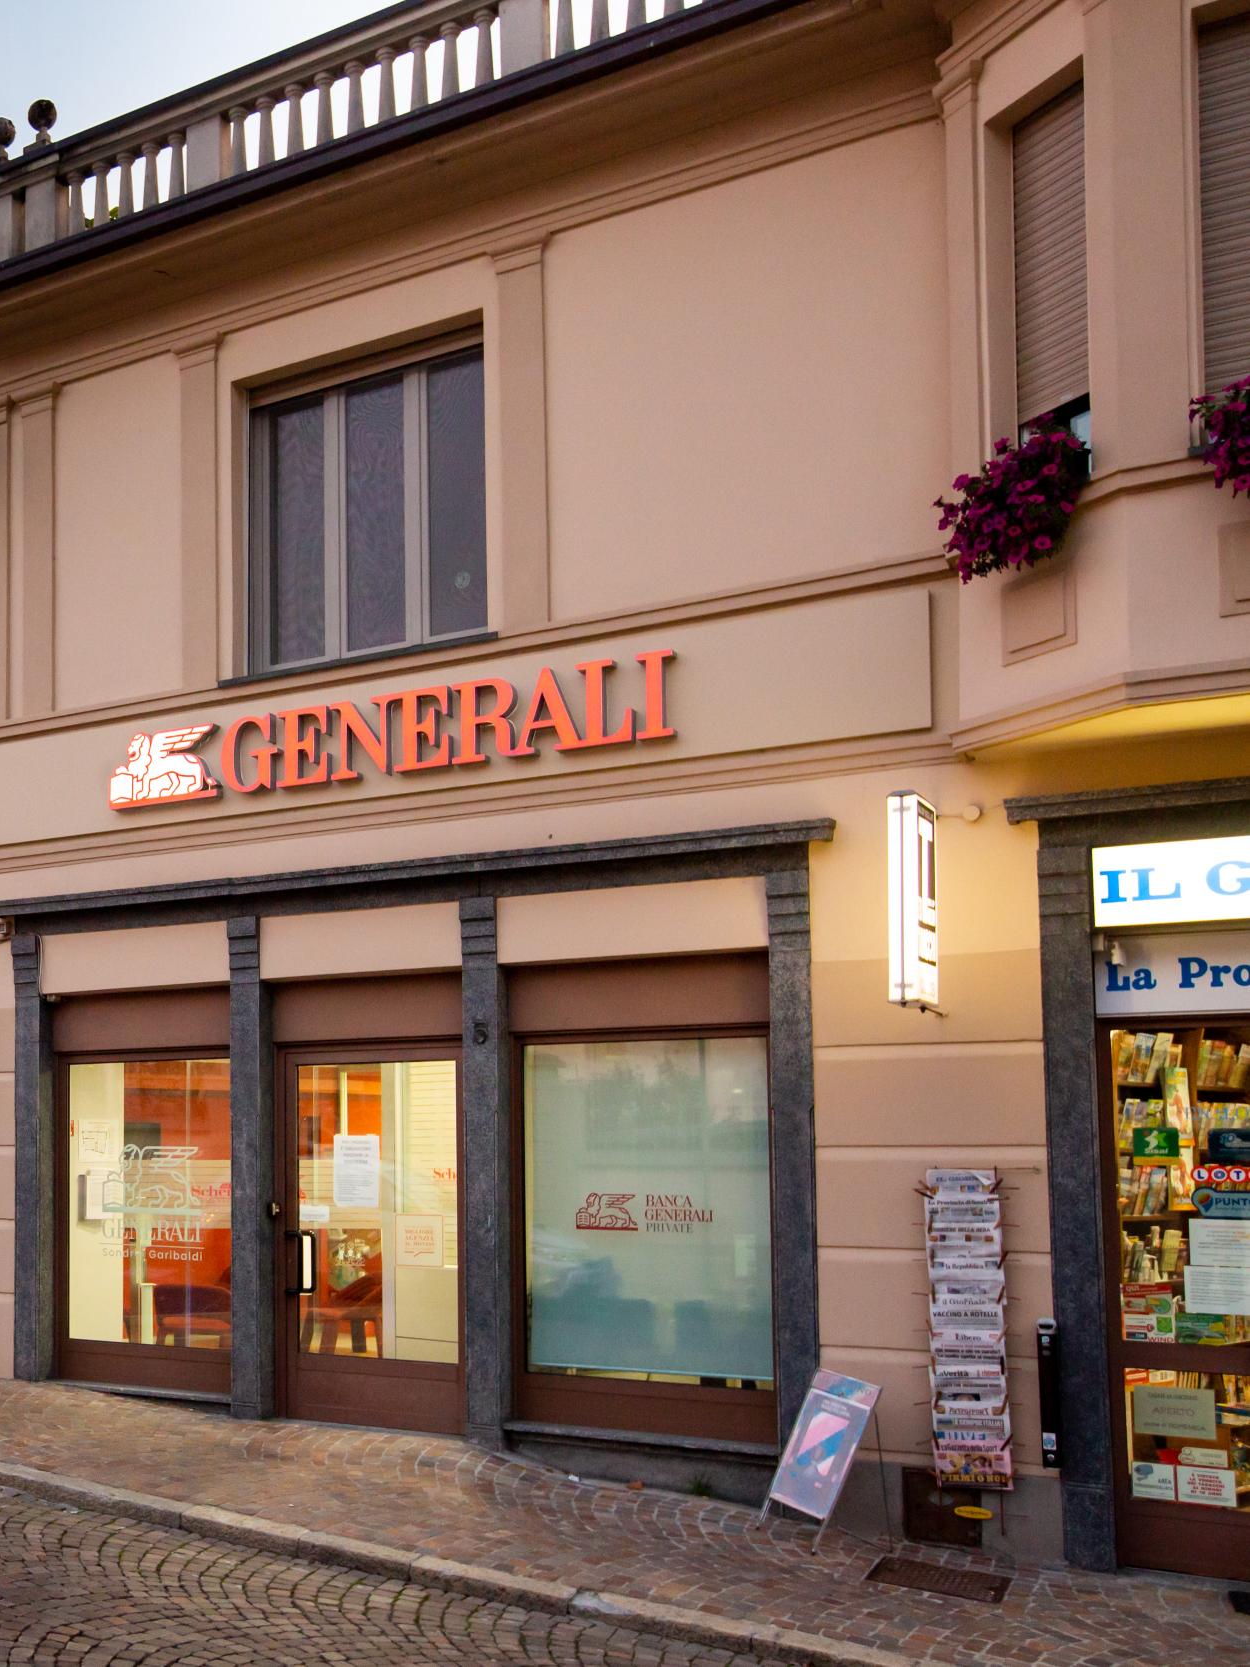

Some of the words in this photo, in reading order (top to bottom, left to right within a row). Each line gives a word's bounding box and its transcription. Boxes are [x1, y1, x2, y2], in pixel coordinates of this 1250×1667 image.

[220, 648, 678, 794] GENERALI
[1099, 867, 1182, 904] IL
[1105, 959, 1157, 992] La
[1178, 956, 1250, 989] Pro
[473, 1022, 488, 1045] 5
[646, 1194, 692, 1208] BANCA
[1215, 1197, 1250, 1206] PUNT
[644, 1208, 713, 1223] GENERALI
[102, 1217, 204, 1243] GENERALI
[646, 1222, 693, 1233] PRIVATE
[148, 1249, 203, 1262] Garibaldi
[955, 1332, 982, 1341] Libero
